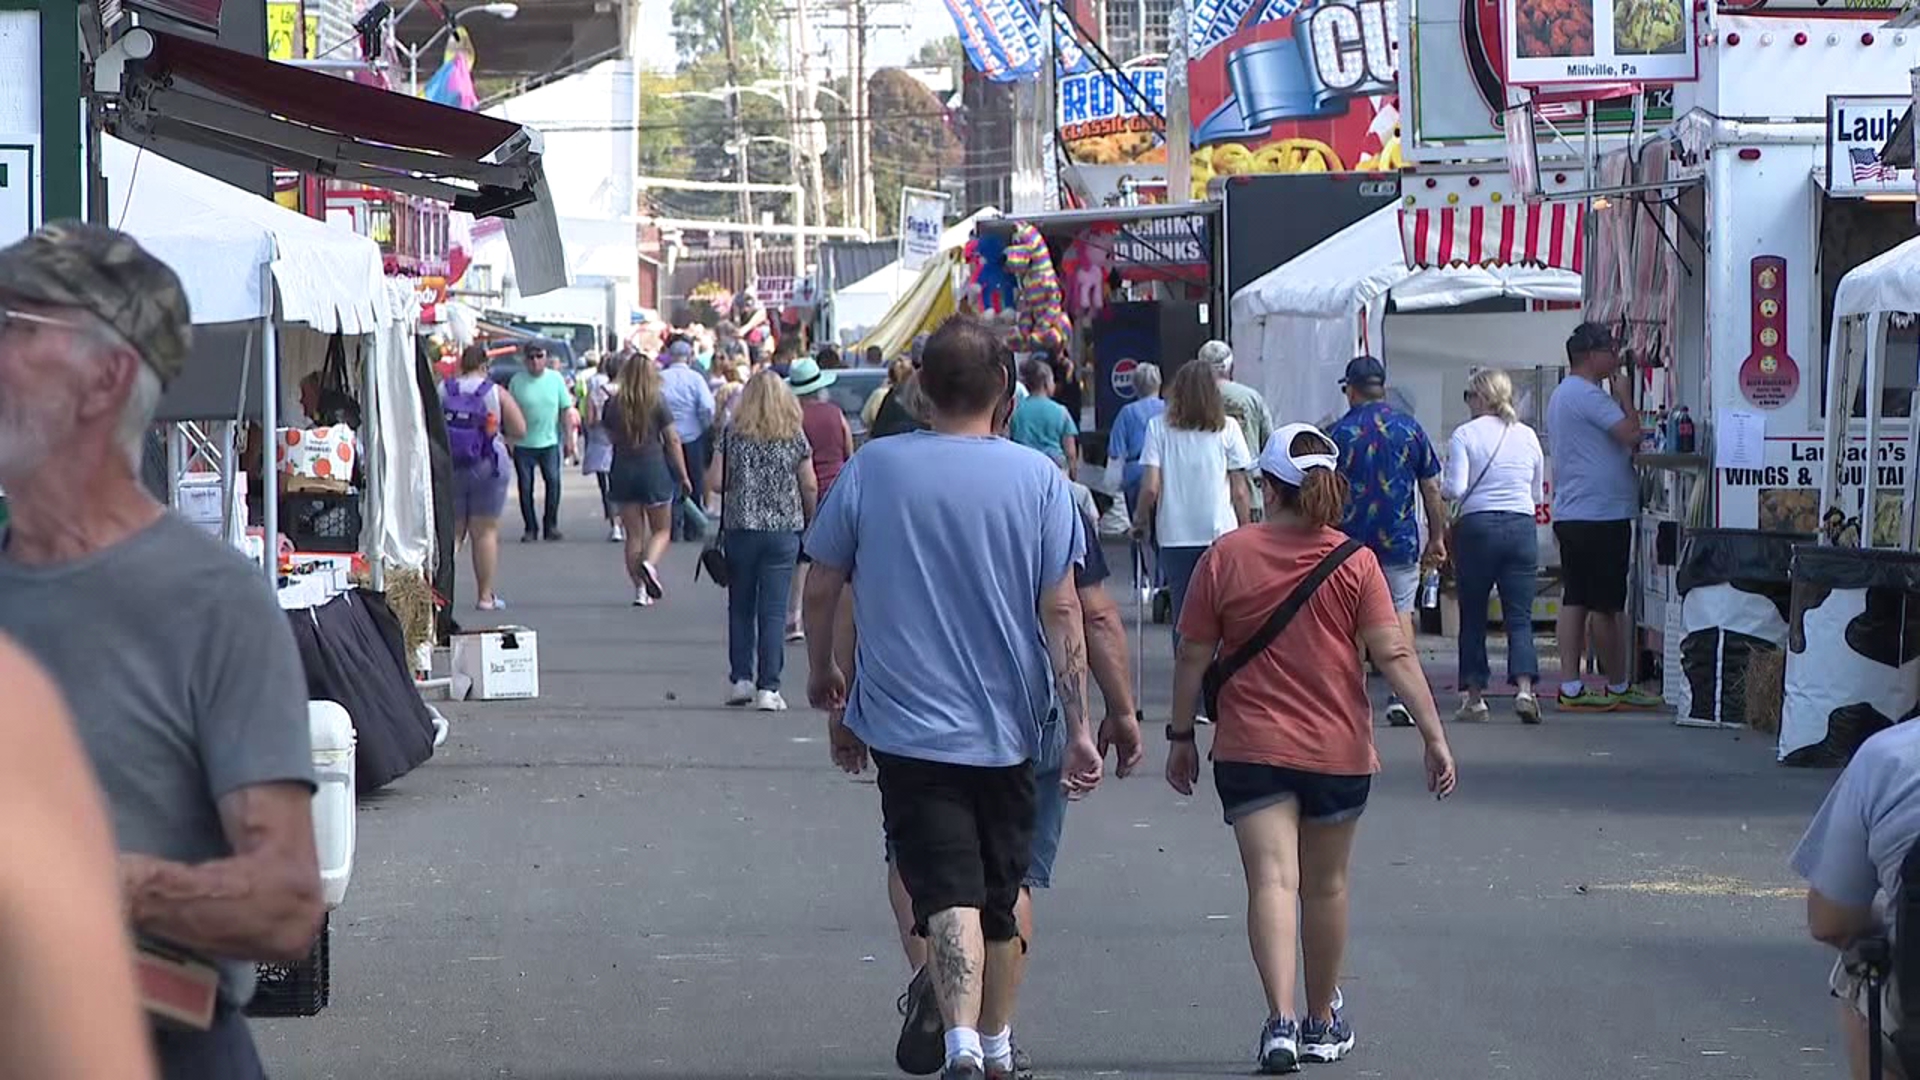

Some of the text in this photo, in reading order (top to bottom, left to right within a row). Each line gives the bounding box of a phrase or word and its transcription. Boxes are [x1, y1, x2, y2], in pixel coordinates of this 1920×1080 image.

[1567, 64, 1637, 77] Millville, Pa
[1726, 466, 1788, 486] WINGS
[1797, 467, 1813, 485] &
